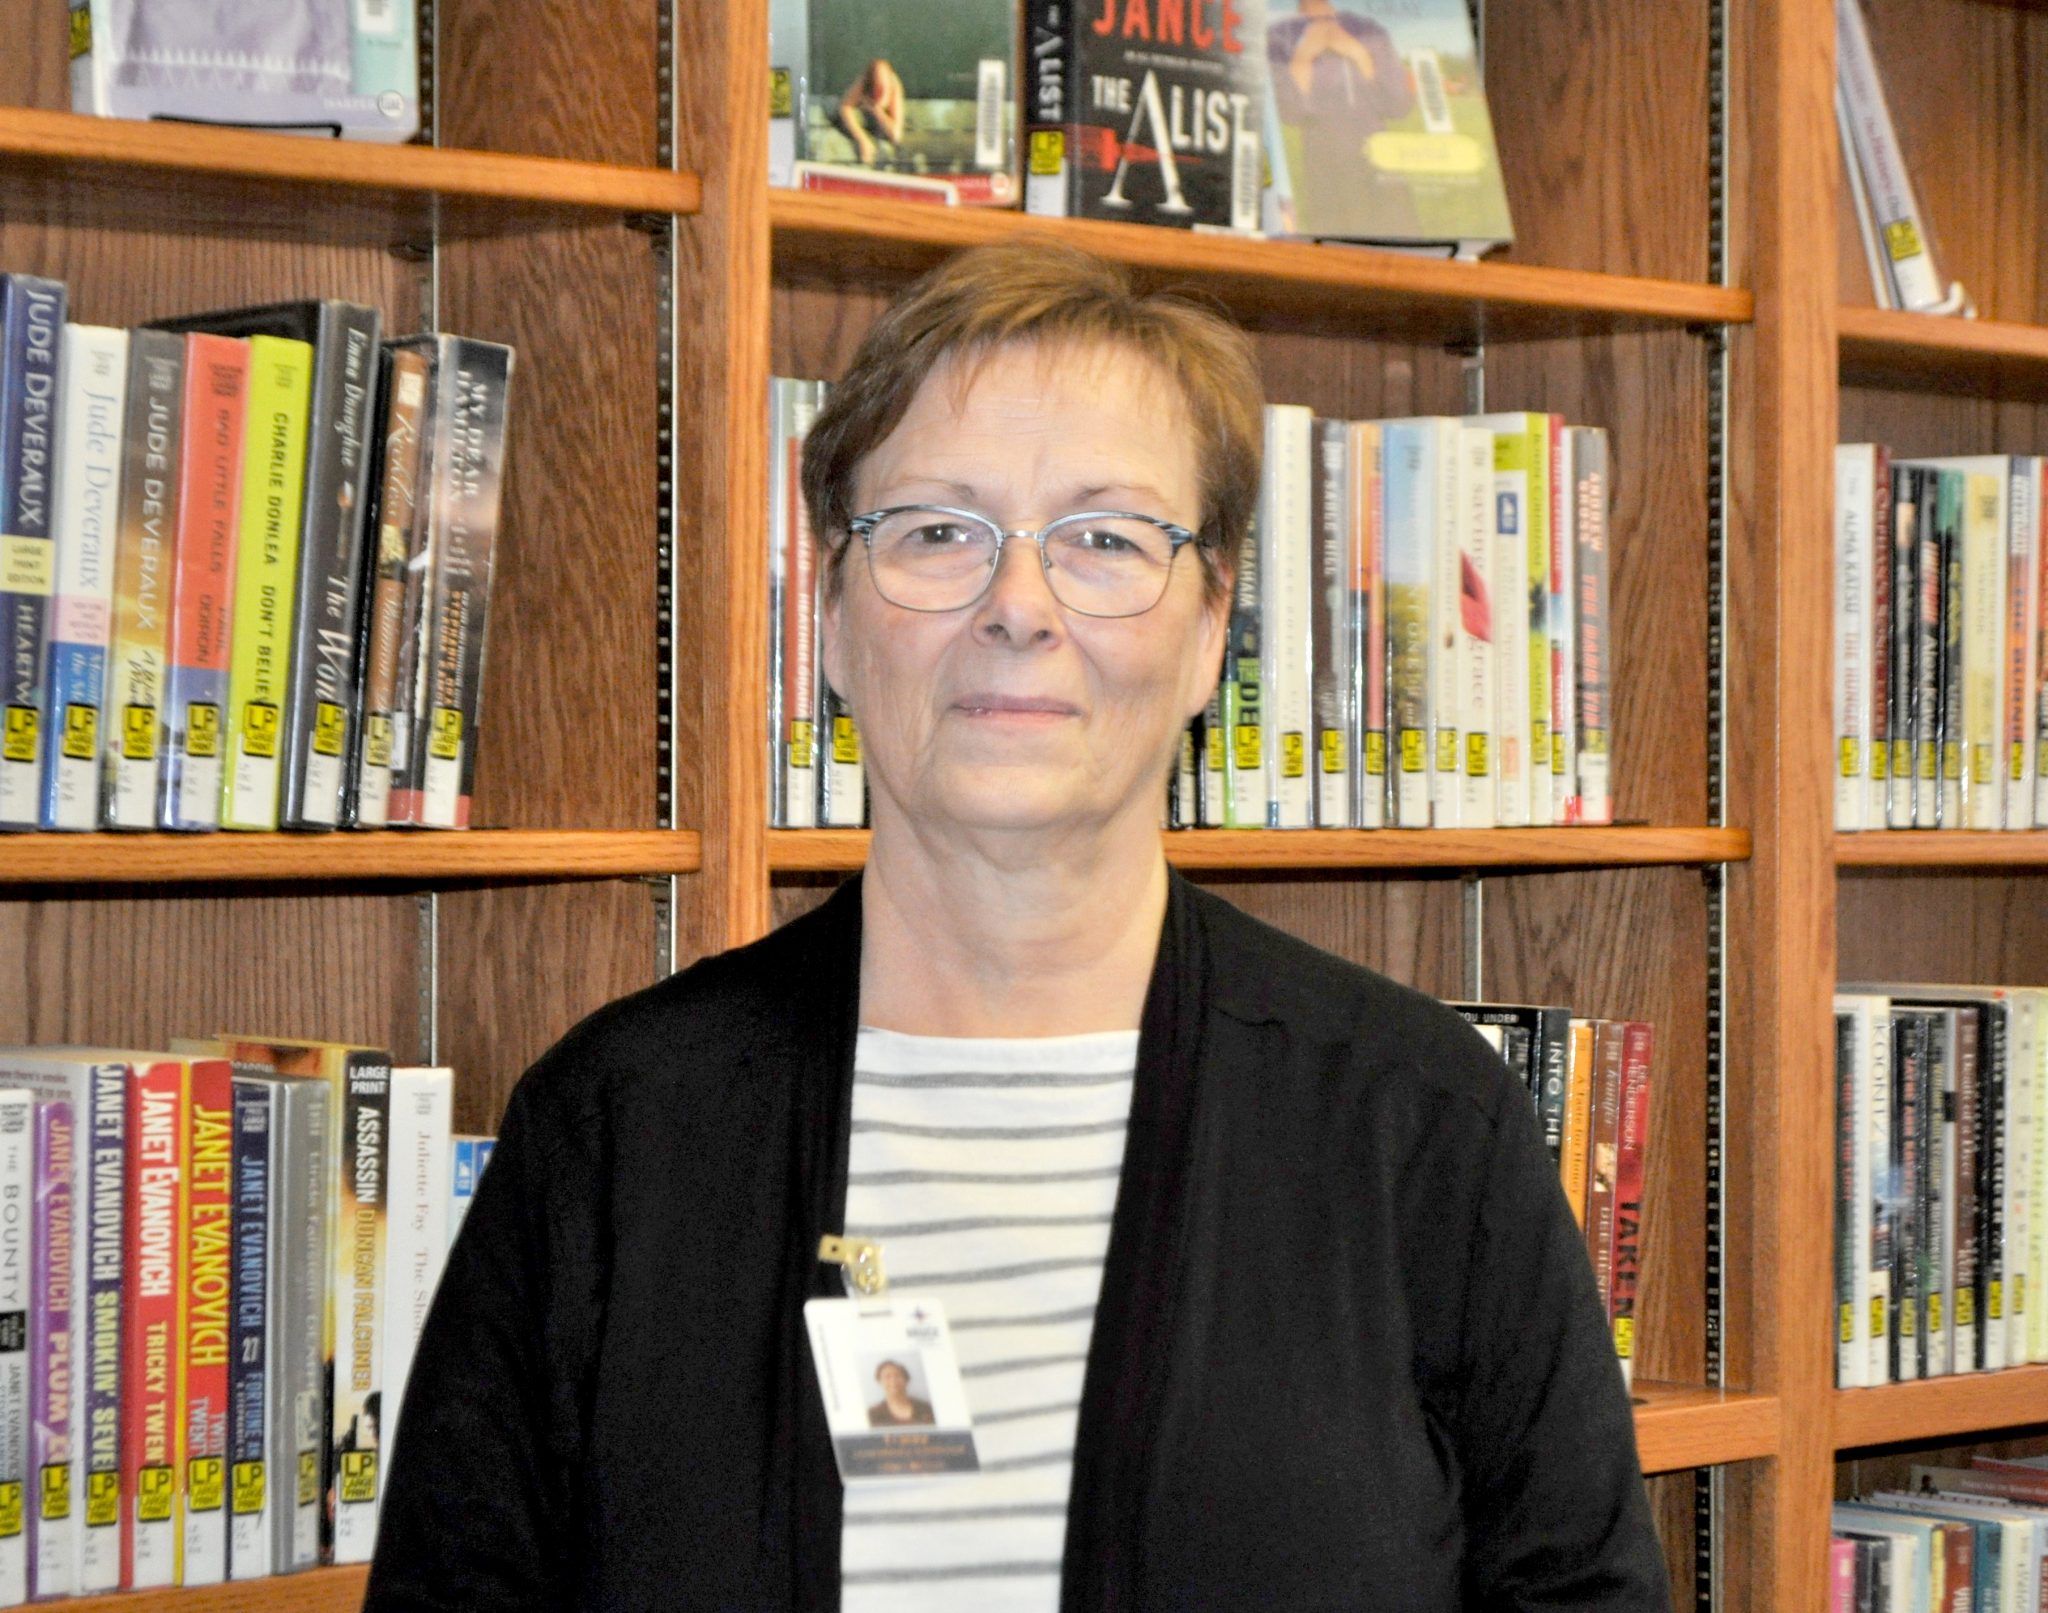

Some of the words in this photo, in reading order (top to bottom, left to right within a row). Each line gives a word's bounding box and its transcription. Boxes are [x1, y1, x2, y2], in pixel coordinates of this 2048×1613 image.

[1092, 0, 1246, 53] JANCE
[1038, 59, 1063, 121] LIST
[1092, 75, 1132, 114] THE
[1170, 86, 1251, 155] LIST
[1101, 69, 1195, 212] A
[25, 289, 58, 363] JUDE
[345, 328, 367, 378] Emma
[81, 388, 118, 454] Jude
[146, 397, 169, 471] JUDE
[333, 383, 365, 468] Donoghue
[469, 384, 488, 418] MY
[18, 371, 54, 526] DEVERAUX
[269, 412, 289, 488] CHARLIE
[213, 455, 229, 510] LITTLE
[79, 463, 113, 590] Deveraux
[136, 478, 164, 630] DEVERAUX
[210, 520, 227, 574] FALLS
[263, 495, 283, 566] DONLEA
[258, 585, 276, 638] DON'T
[327, 576, 349, 617] The
[9, 708, 34, 732] LP
[69, 708, 94, 731] LP
[130, 707, 154, 732] LP
[191, 706, 217, 730] LP
[250, 705, 275, 730] LP
[1483, 1012, 1520, 1024] UNDER
[350, 1066, 389, 1080] LARGE
[351, 1081, 387, 1095] PRINT
[1546, 1041, 1564, 1095] INTO
[1871, 1025, 1889, 1140] KOONTZ
[96, 1064, 125, 1141] JANET
[140, 1088, 178, 1164] JANET
[1545, 1104, 1561, 1147] THE
[1623, 1057, 1641, 1152] HENDERSON
[47, 1119, 72, 1183] JANET
[192, 1103, 233, 1195] JANET
[355, 1106, 382, 1204] ASSASSIN
[92, 1147, 123, 1281] EVANOVICH
[239, 1154, 265, 1216] JANET
[2, 1185, 20, 1304] BOUNTY
[47, 1194, 72, 1312] EVANOVICH
[139, 1166, 180, 1298] EVANOVICH
[353, 1208, 377, 1289] DUNCAN
[1614, 1201, 1642, 1319] TAKEN
[189, 1203, 231, 1367] EVANOVICH
[238, 1220, 264, 1328] EVANOVICH
[92, 1290, 119, 1397] SMOKIN'
[145, 1320, 169, 1394] TRICKY
[242, 1335, 261, 1364] 27
[350, 1292, 376, 1392] FALCONER
[47, 1332, 71, 1425] PLUM
[244, 1372, 264, 1438] FORTUNE
[90, 1475, 116, 1501] LP
[142, 1471, 170, 1498] LP
[192, 1461, 220, 1486] LP
[235, 1465, 263, 1489] LP
[344, 1454, 374, 1478] LP
